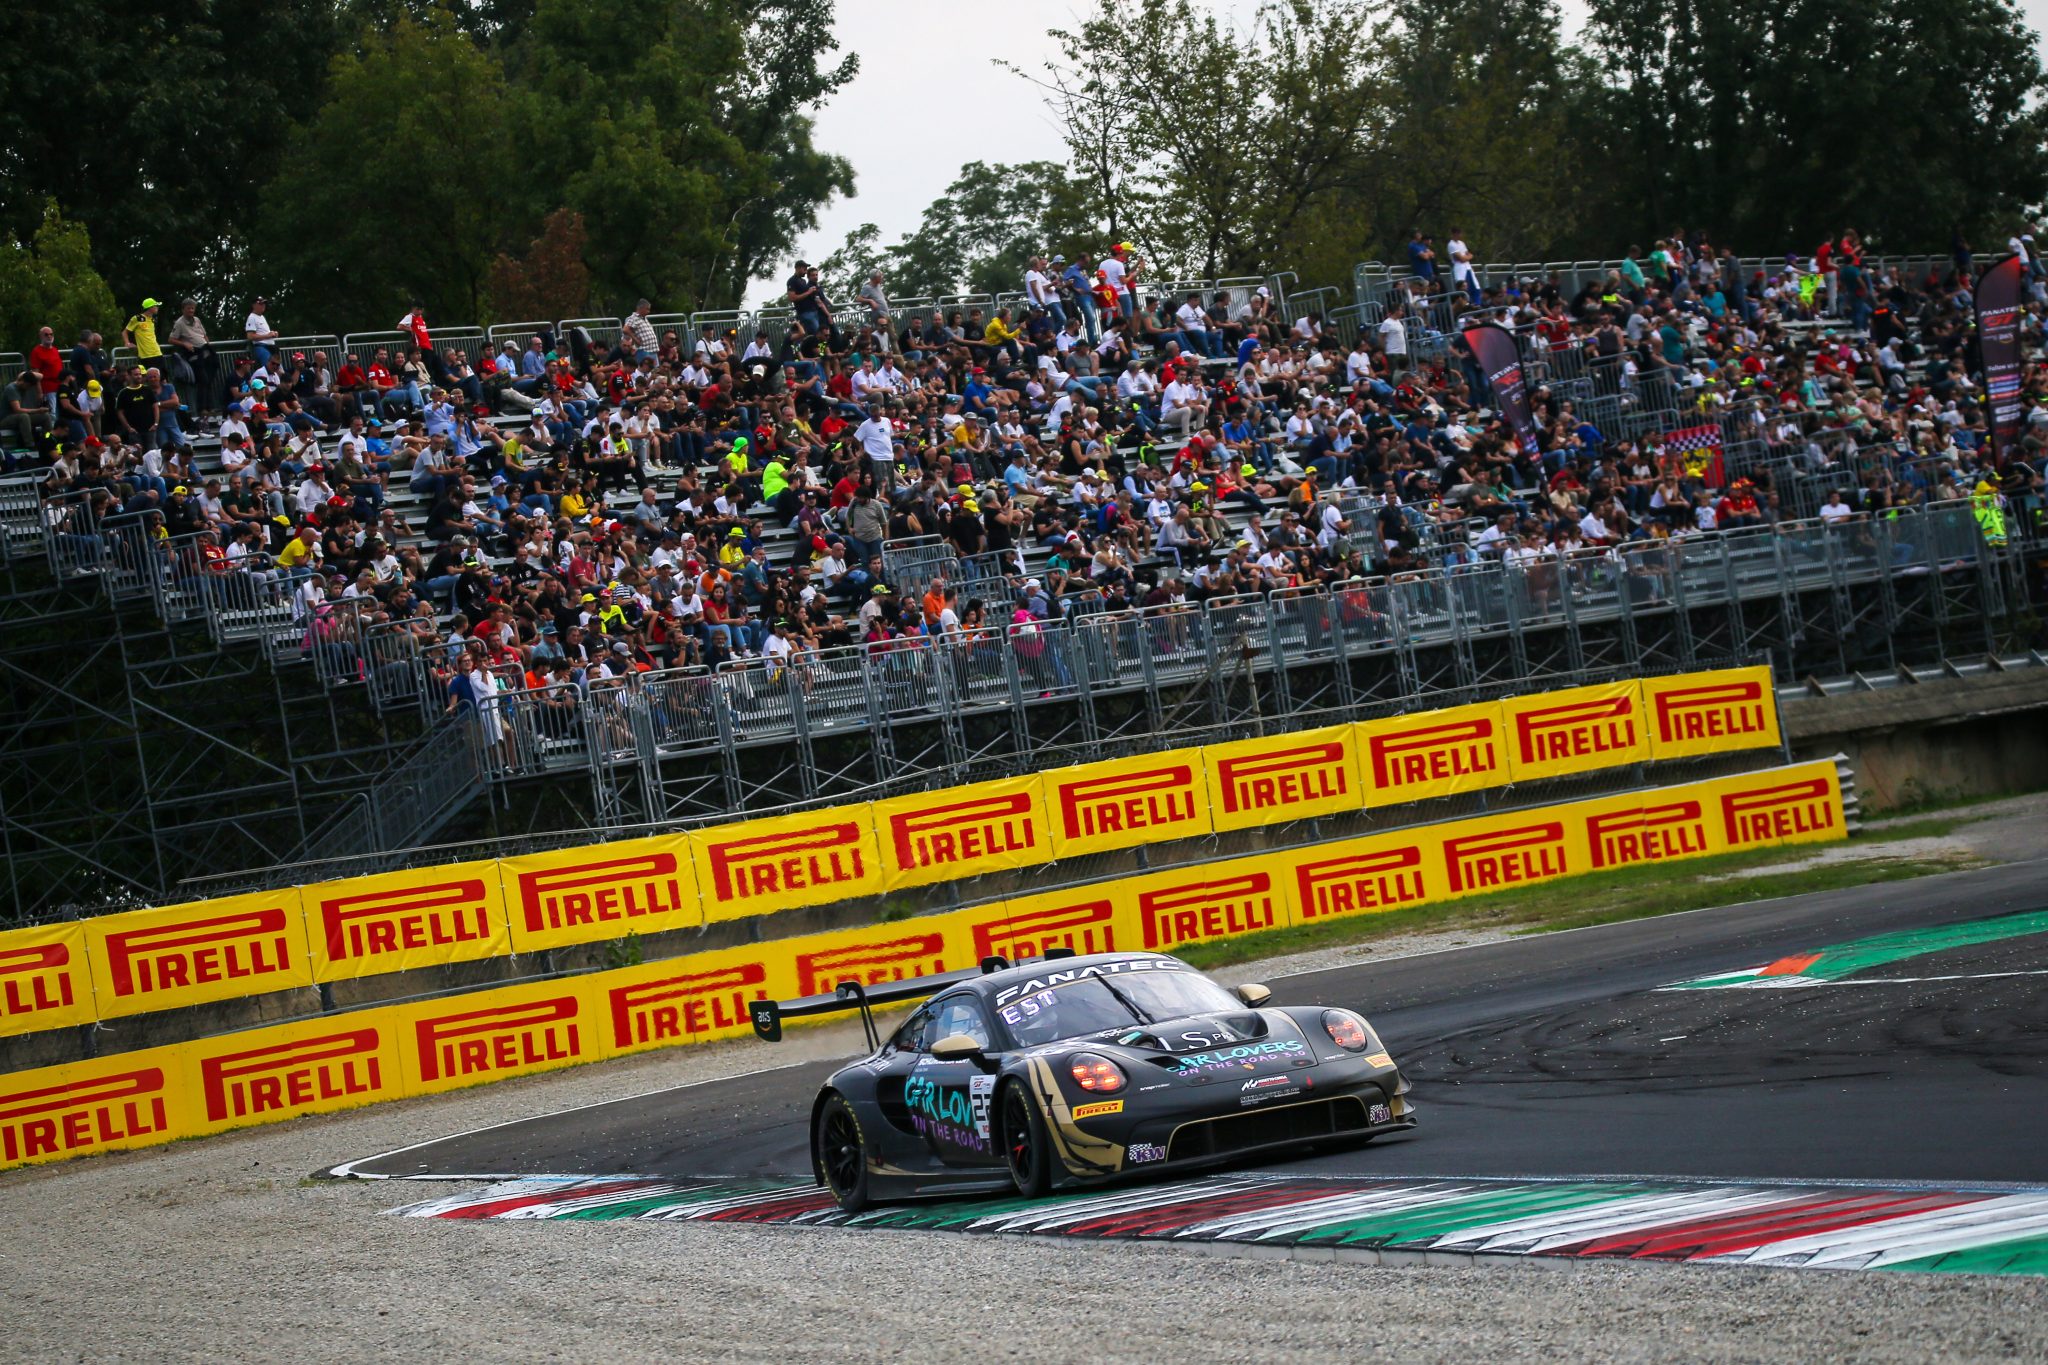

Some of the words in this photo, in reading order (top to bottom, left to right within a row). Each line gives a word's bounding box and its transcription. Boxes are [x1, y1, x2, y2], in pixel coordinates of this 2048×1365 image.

[1981, 305, 2018, 316] FANATE
[1517, 697, 1635, 764] PIRELLI
[1656, 683, 1765, 742] PIRELLI
[1219, 743, 1346, 813] PIRELLI
[1371, 719, 1496, 789] PIRELLI
[891, 793, 1035, 870] PIRELLI
[1060, 766, 1196, 839] PIRELLI
[1587, 801, 1706, 868] PIRELLI
[1722, 779, 1833, 845] PIRELLI
[709, 822, 865, 902] PIRELLI
[1296, 847, 1425, 918] PIRELLI
[1444, 823, 1567, 892] PIRELLI
[321, 880, 490, 961] PIRELLI
[519, 854, 681, 932] PIRELLI
[1140, 873, 1274, 949] PIRELLI
[106, 909, 290, 997] PIRELLI
[996, 960, 1180, 1006] FANATEC
[416, 997, 580, 1081] PIRELLI
[757, 1011, 771, 1022] aws
[1001, 990, 1054, 1025] EST
[201, 1028, 381, 1121] PIRELLI
[1166, 1056, 1217, 1073] CAR
[1216, 1040, 1304, 1062] LOVERS
[1178, 1067, 1199, 1077] ON
[1207, 1061, 1234, 1072] THE
[1240, 1053, 1278, 1066] ROAD
[1283, 1050, 1306, 1058] 3.0
[904, 1076, 940, 1121] CAR
[940, 1086, 977, 1130] LOV
[929, 1120, 951, 1140] THE
[953, 1128, 984, 1152] ROAD
[1076, 1102, 1119, 1117] PIRELLI
[1135, 1145, 1167, 1163] KW
